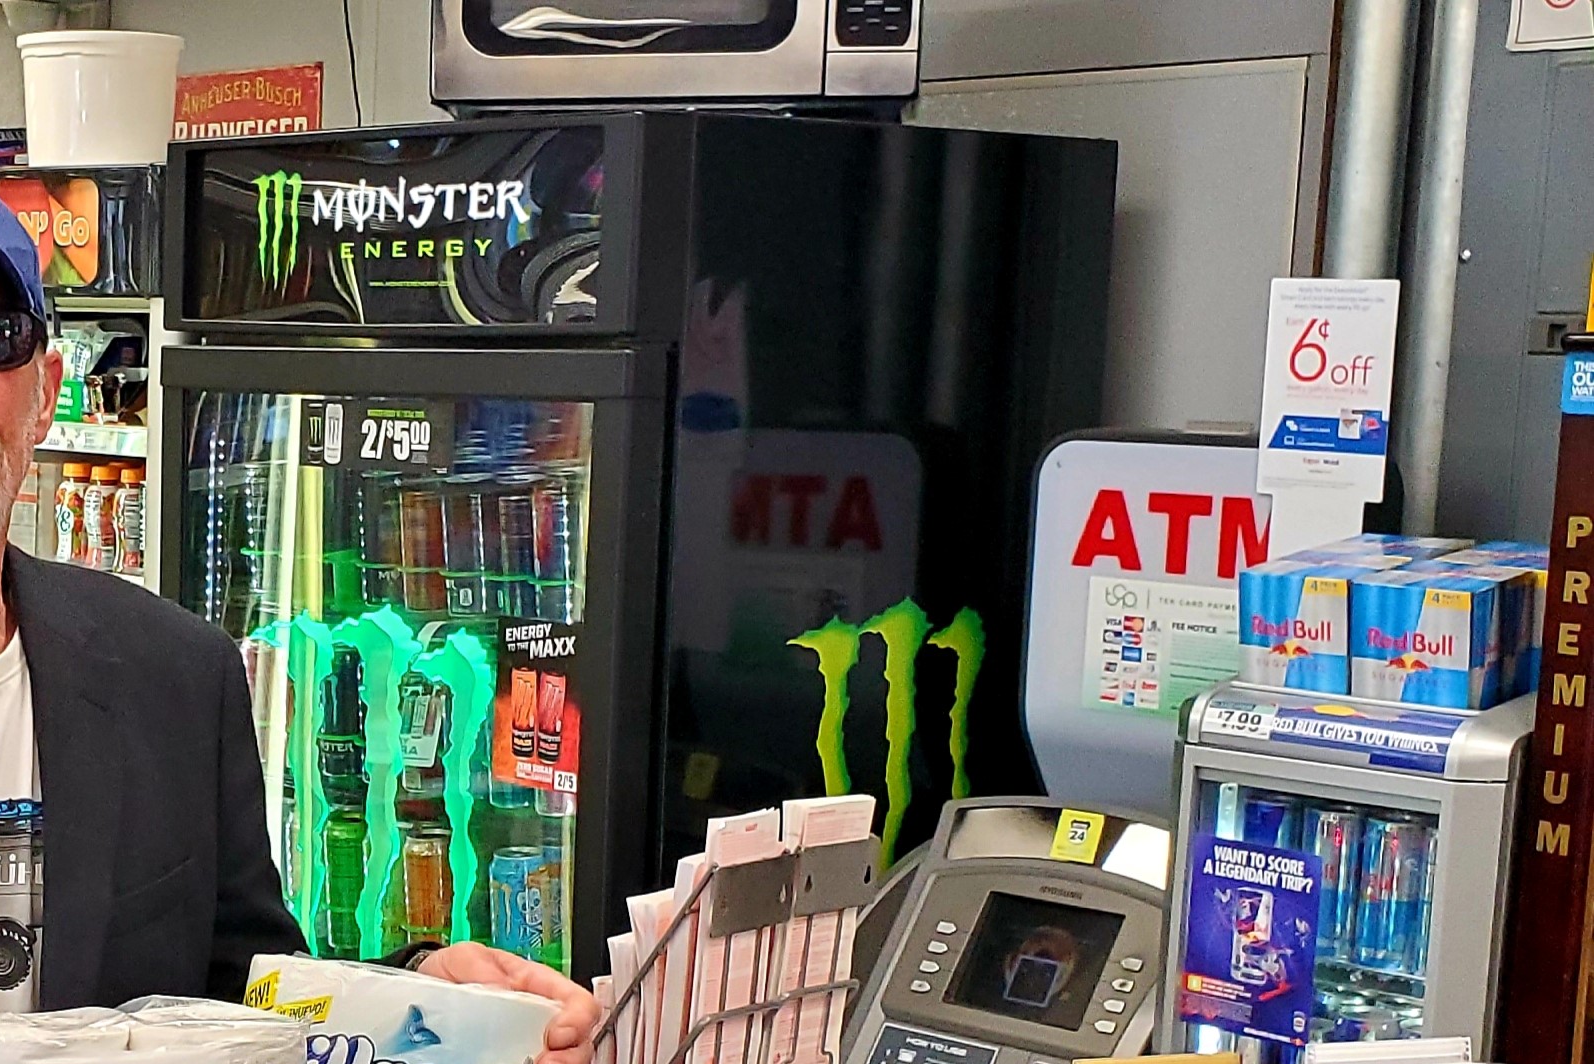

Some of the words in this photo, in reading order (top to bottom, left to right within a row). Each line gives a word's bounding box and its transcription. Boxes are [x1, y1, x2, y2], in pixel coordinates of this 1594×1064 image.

[312, 176, 531, 232] MONSTER
[340, 239, 492, 260] ENERGY
[1330, 355, 1375, 386] off
[1310, 580, 1318, 591] 4
[1431, 592, 1440, 604] 4
[505, 623, 553, 642] ENERGY
[1106, 618, 1122, 626] VISA
[1172, 622, 1185, 630] FEE
[1187, 624, 1217, 634] NOTICE
[1251, 615, 1289, 637] Red
[1293, 619, 1332, 642] Bull
[529, 636, 576, 660] MAXX
[1367, 626, 1408, 651] Red
[1412, 633, 1454, 657] Bull
[1536, 515, 1593, 857] PREMIUM
[1273, 717, 1294, 731] RED
[1295, 719, 1323, 737] BULL
[1323, 723, 1356, 741] GIVES
[1068, 829, 1088, 844] 24
[1213, 845, 1249, 862] WANT
[1249, 851, 1266, 868] TO
[1267, 855, 1305, 876] SCORE
[1203, 858, 1213, 874] A
[1215, 861, 1279, 887] LEGENDARY
[1280, 873, 1314, 894] TRIP?
